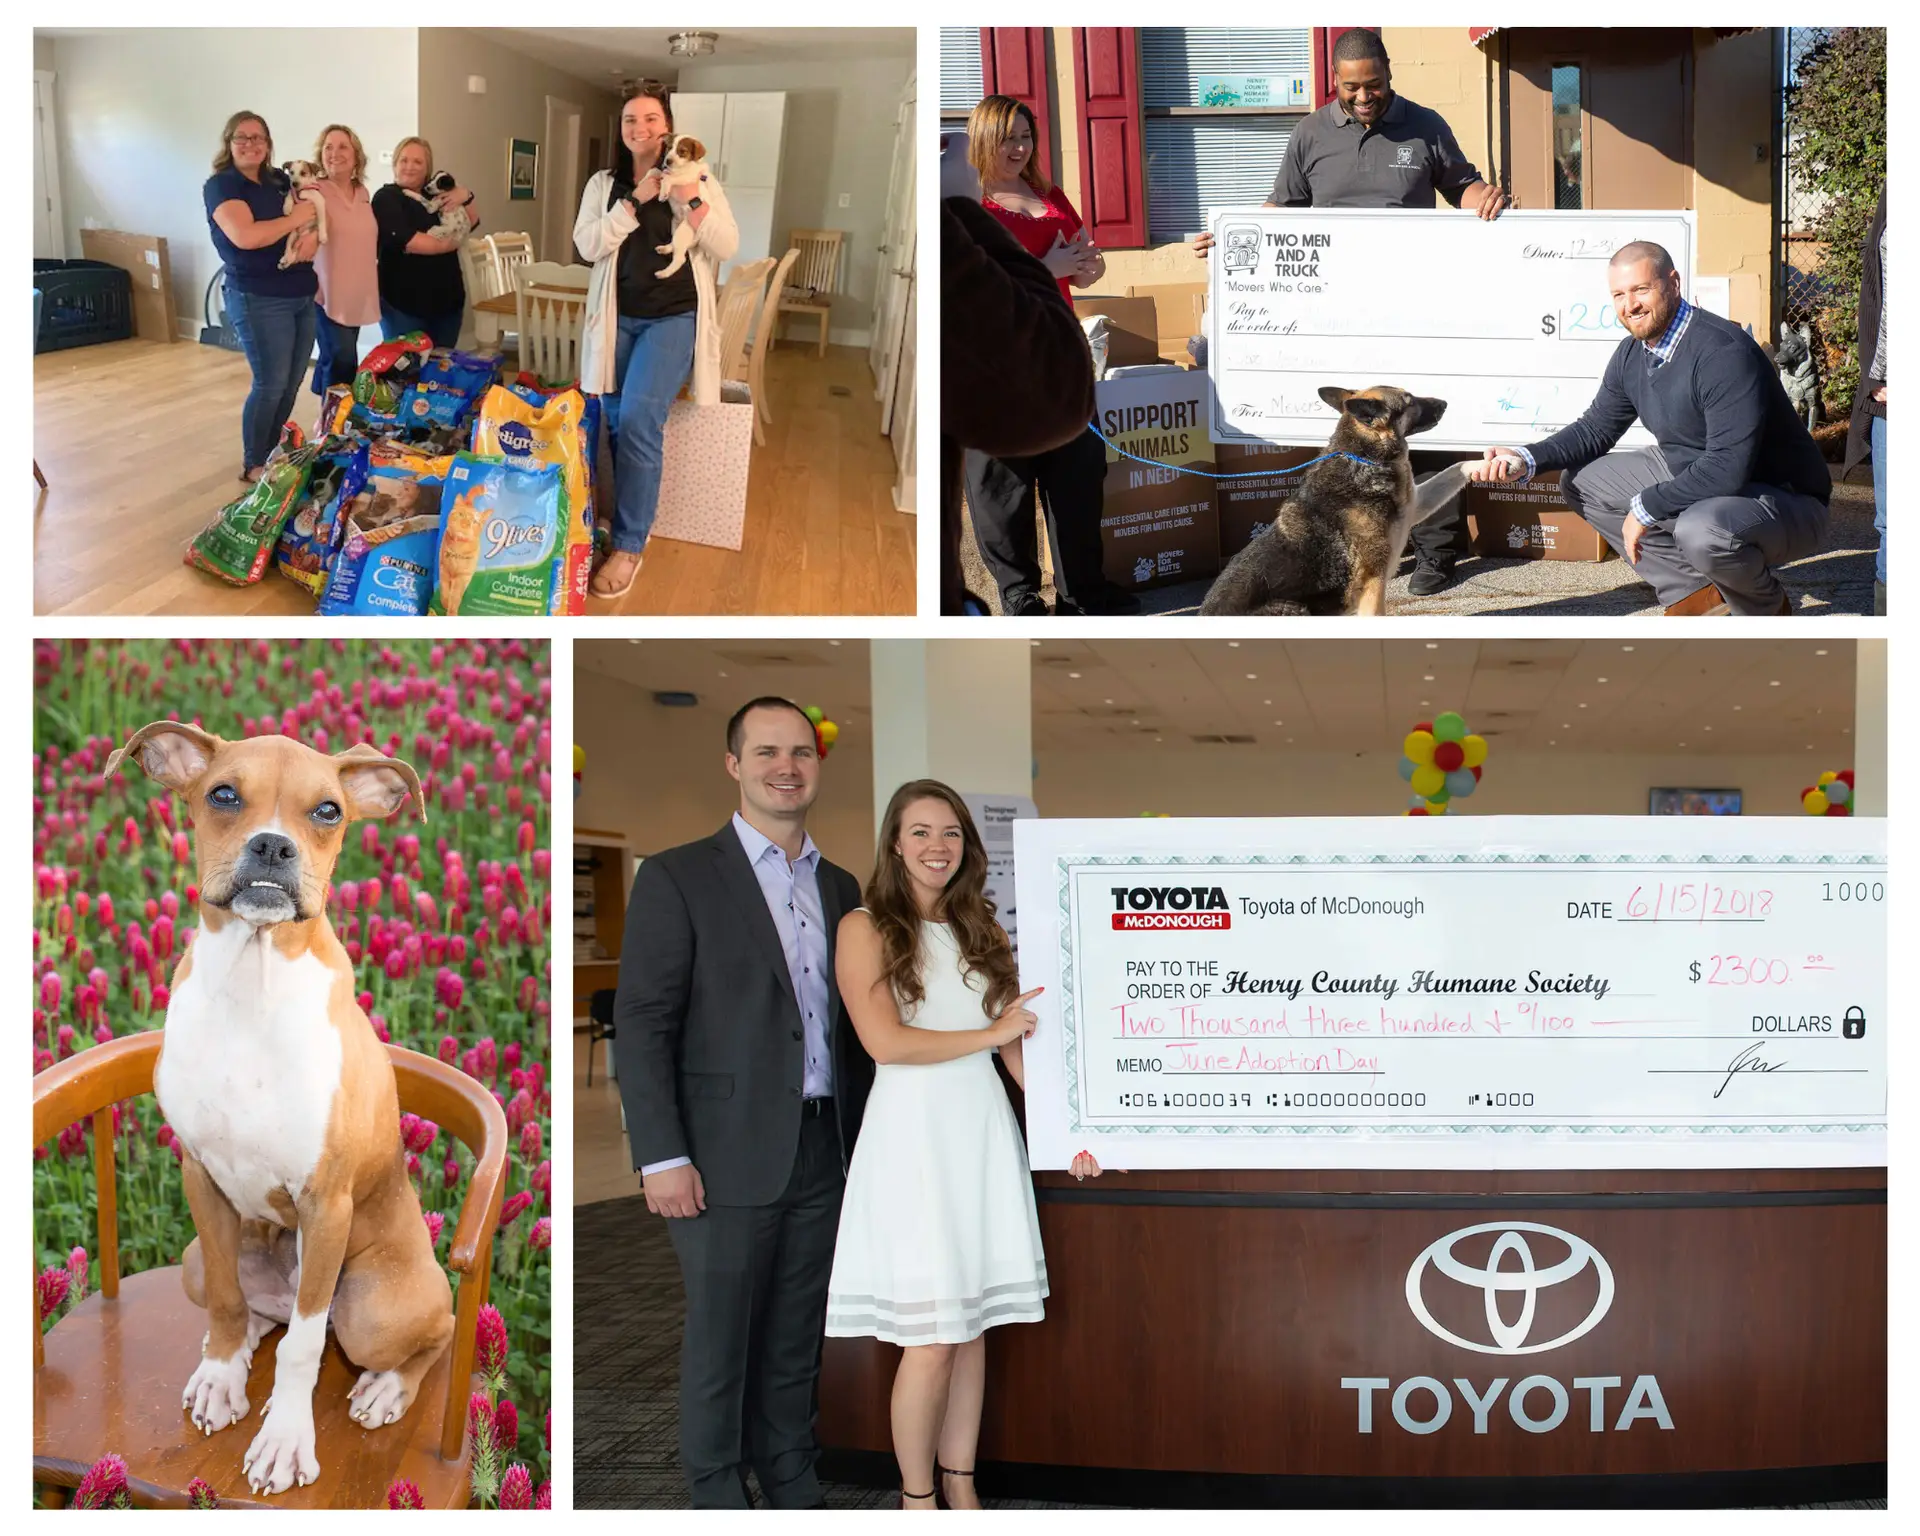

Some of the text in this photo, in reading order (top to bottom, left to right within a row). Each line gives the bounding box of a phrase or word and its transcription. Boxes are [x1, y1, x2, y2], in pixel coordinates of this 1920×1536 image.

[1265, 233, 1331, 247] TWO MEN
[1276, 249, 1320, 262] AND A
[1522, 243, 1564, 259] Date:
[1275, 264, 1319, 277] TRUCK
[1269, 281, 1293, 293] Who
[1229, 301, 1269, 321] Pay to
[1227, 319, 1245, 332] the
[1247, 319, 1280, 333] order
[1282, 319, 1298, 335] of:
[1541, 313, 1556, 337] $
[1232, 395, 1322, 418] For: Movers
[1104, 400, 1199, 438] SUPPORT
[1118, 433, 1190, 461] ANIMALS
[1129, 470, 1143, 489] IN
[1237, 479, 1270, 489] ESSENTIAL
[1270, 478, 1287, 486] CARE
[1496, 481, 1529, 491] ESSENTIAL
[1529, 482, 1546, 492] CARE
[1230, 491, 1256, 502] MOVERS
[1256, 490, 1268, 500] FOR
[1269, 489, 1289, 499] MUTTS
[1488, 491, 1514, 502] MOVERS
[1514, 492, 1527, 502] FOR
[1527, 493, 1548, 504] MUTTS
[1100, 501, 1210, 528] ONATE ESSENTIAL CARE ITEMS TO THE
[1113, 525, 1140, 538] MOVERS
[1140, 523, 1152, 534] FOR
[1152, 520, 1173, 532] MUTTS
[1531, 524, 1559, 533] MOVERS
[1531, 537, 1555, 546] MUTTS
[1157, 549, 1184, 559] MOVERS
[1157, 558, 1172, 566] FOR
[390, 556, 428, 577] PURINA
[1157, 562, 1181, 573] MUTTS
[507, 572, 544, 587] Indoor
[491, 581, 543, 600] Complete
[367, 593, 419, 615] Complete
[984, 805, 1017, 815] Designed
[1111, 887, 1230, 911] TOYOTA
[1822, 882, 1884, 902] 1000
[1239, 896, 1424, 919] Toyota of McDonough
[1567, 902, 1613, 919] DATE
[1625, 882, 1775, 925] 6/15/2018
[1124, 914, 1223, 928] McDONOUGH
[1126, 960, 1218, 976] PAY TO THE
[1689, 960, 1702, 983] $
[1127, 983, 1212, 999] ORDER OF
[1221, 969, 1612, 1001] Henry County Humane Society
[1110, 1002, 1166, 1037] Two
[1168, 1003, 1293, 1040] Thousand
[1300, 1005, 1372, 1035] three
[1380, 1006, 1476, 1034] hundred
[1752, 1016, 1832, 1033] DOLLARS
[1116, 1058, 1163, 1073] MEMO
[1165, 1042, 1379, 1088] June Adoption Day
[1340, 1374, 1676, 1435] TOYOTA
